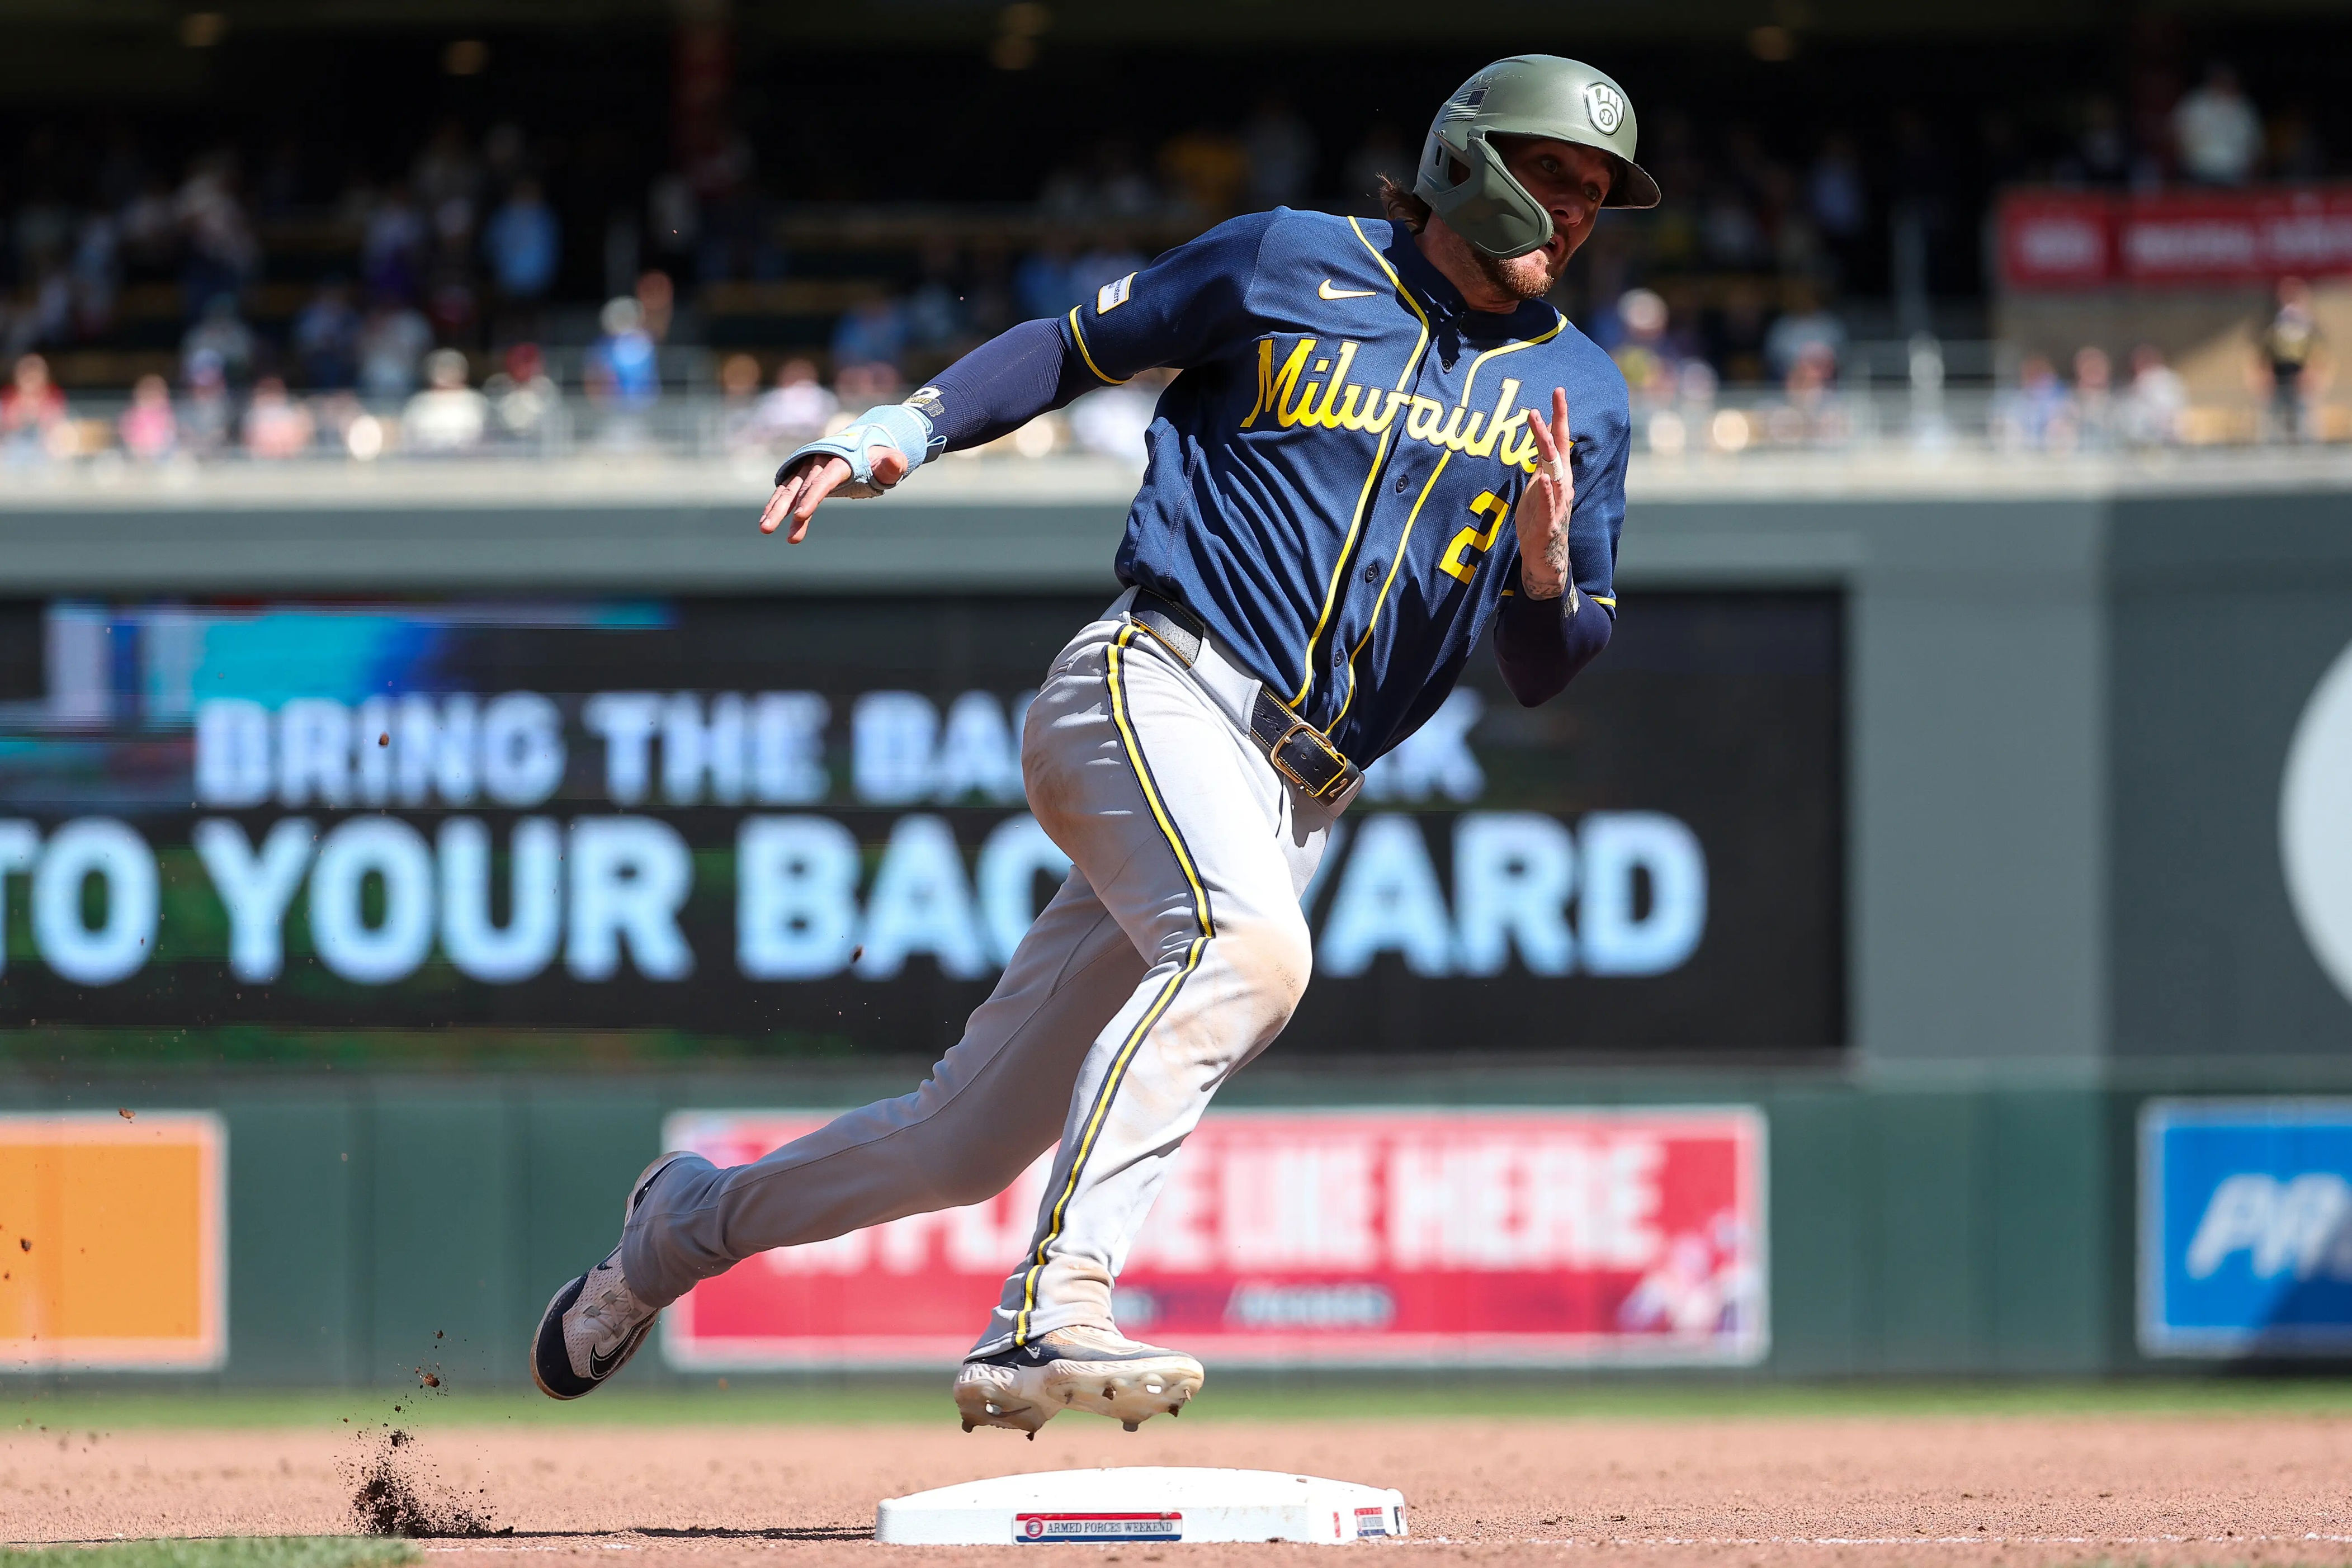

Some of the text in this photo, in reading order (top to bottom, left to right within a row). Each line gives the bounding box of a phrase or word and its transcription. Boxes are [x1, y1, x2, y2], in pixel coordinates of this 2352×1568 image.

[1438, 490, 1510, 585] 2
[195, 695, 561, 802] BRING
[591, 695, 823, 802] THE
[1328, 778, 1348, 798] 2
[199, 818, 691, 981] YOUR
[739, 814, 1706, 975] BACARD
[1047, 1521, 1173, 1533] ARMED FORCES WEEKEND
